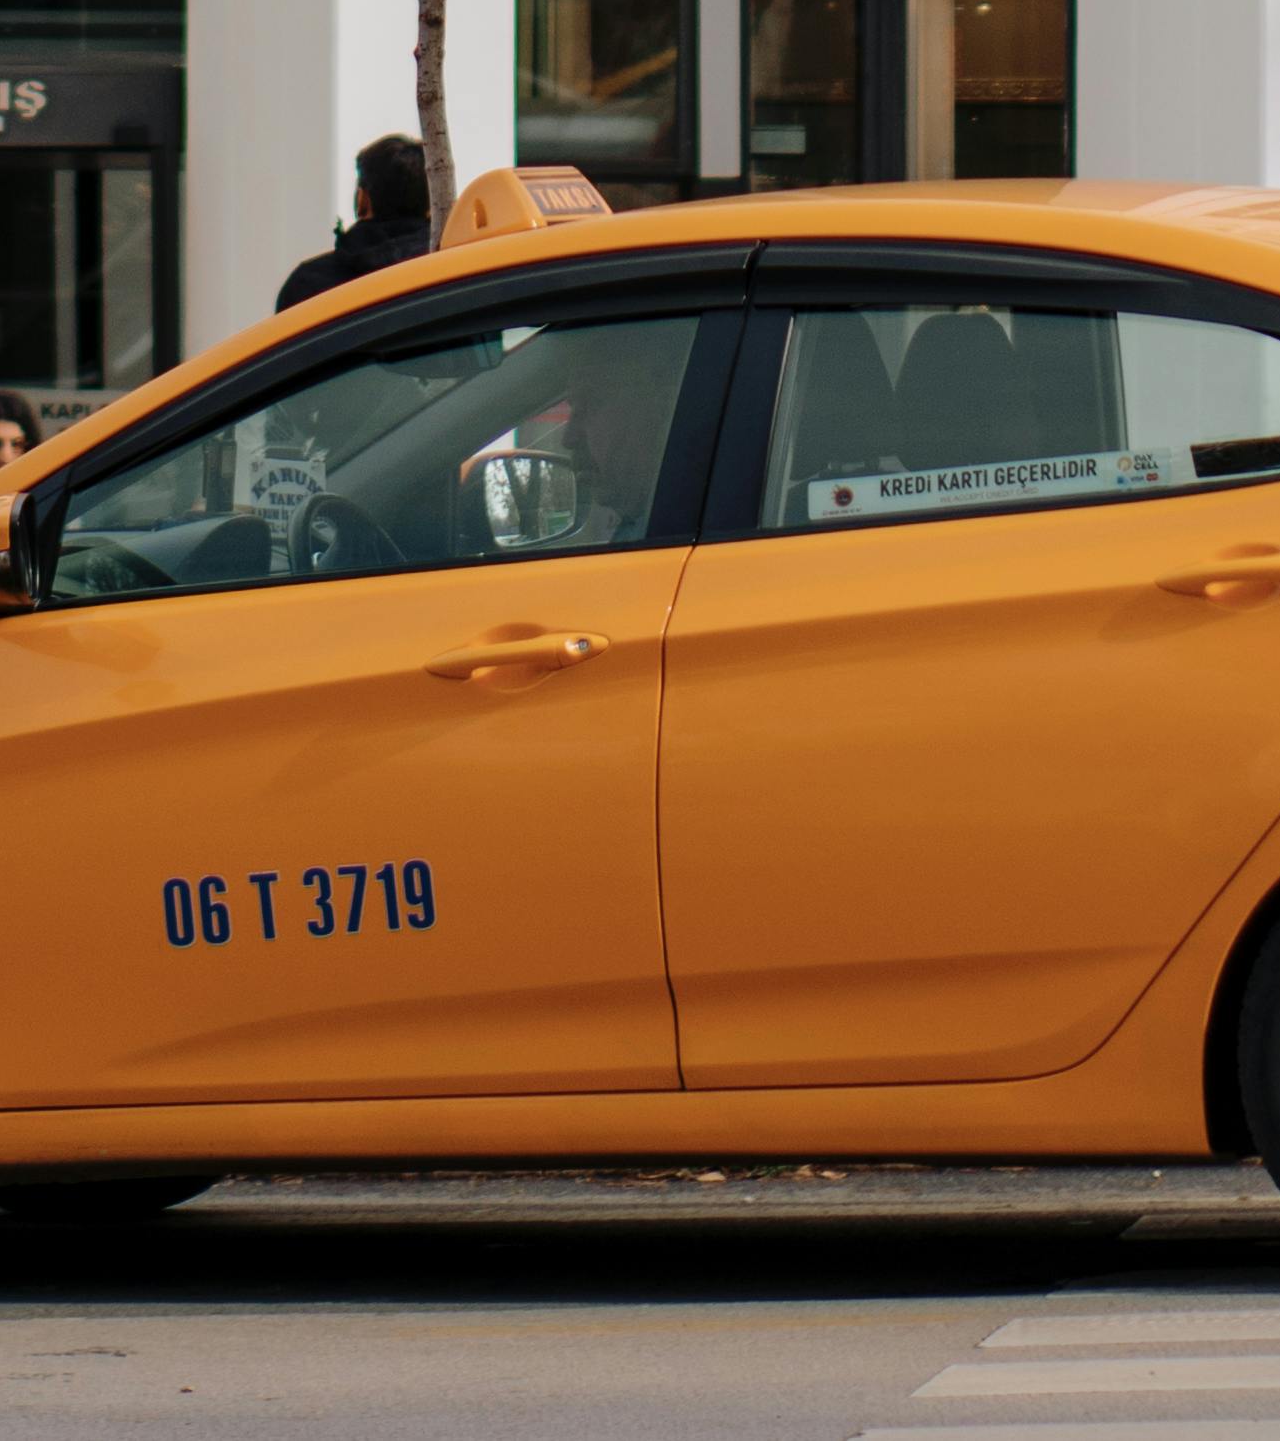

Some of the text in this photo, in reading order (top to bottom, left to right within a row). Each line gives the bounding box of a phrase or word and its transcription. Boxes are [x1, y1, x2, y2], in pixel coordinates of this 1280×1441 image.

[937, 469, 988, 492] KARTI
[163, 858, 437, 947] 06 T 3719
